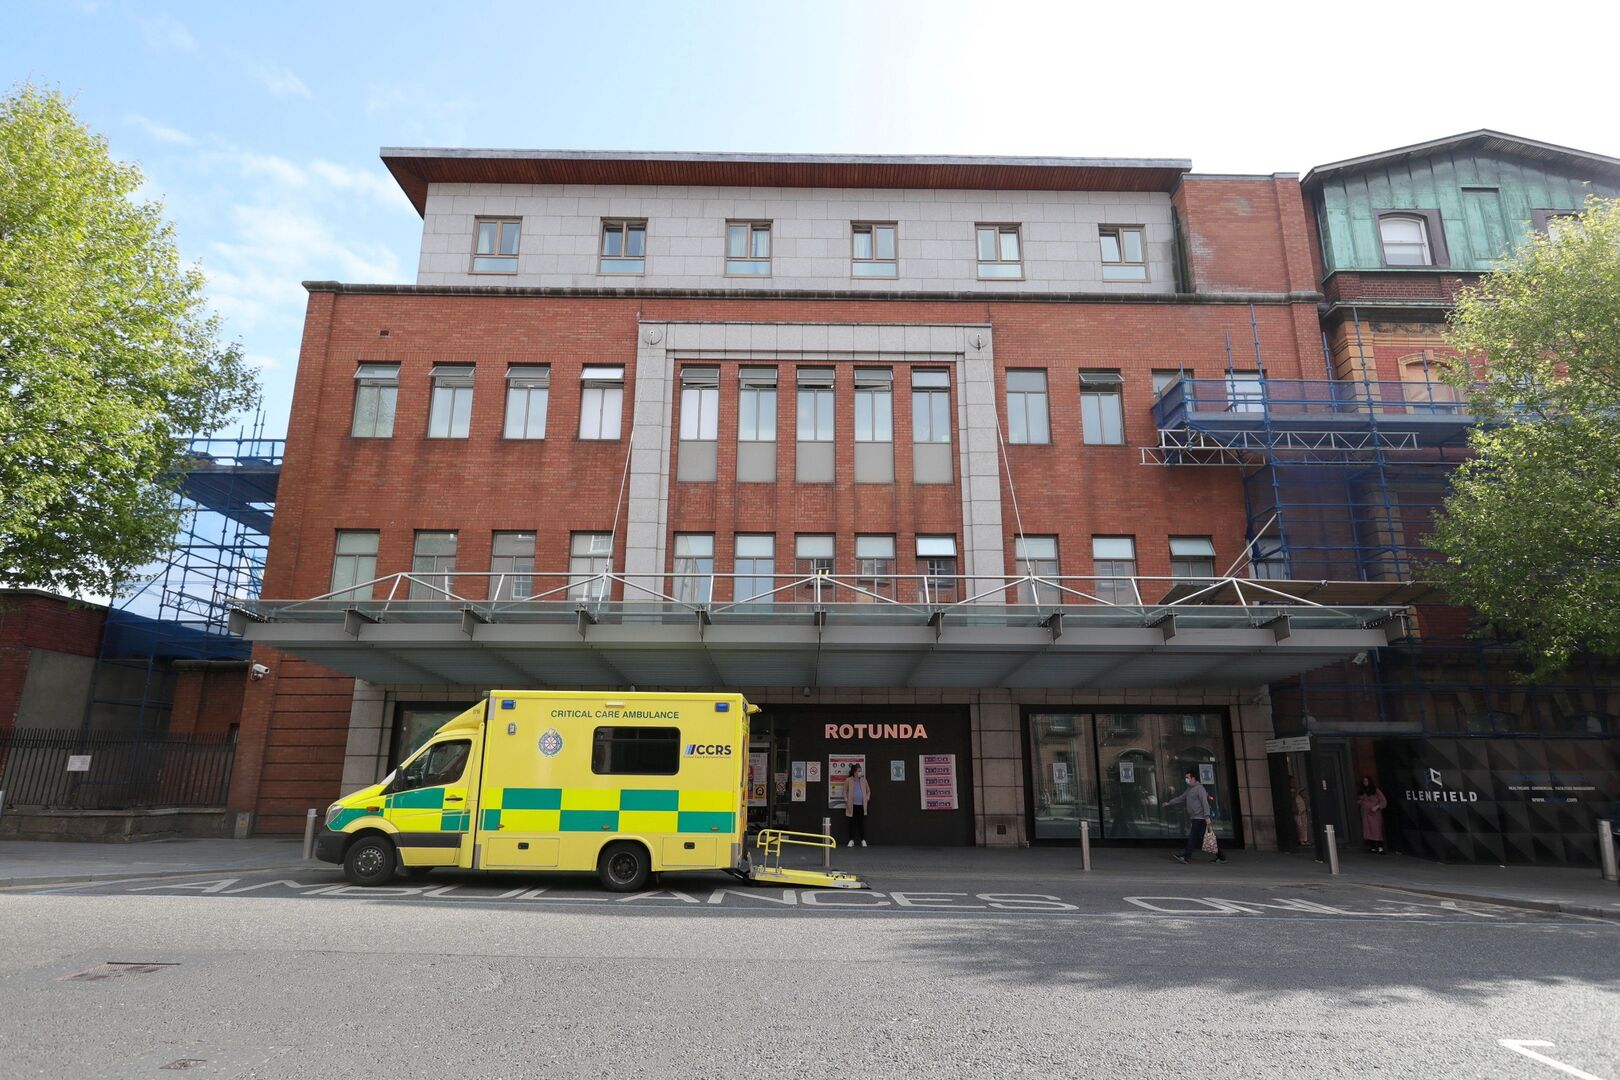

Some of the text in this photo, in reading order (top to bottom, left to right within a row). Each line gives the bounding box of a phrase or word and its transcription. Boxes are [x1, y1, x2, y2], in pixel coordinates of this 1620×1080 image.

[550, 709, 680, 720] CRITICAL CARE AMBULANCE
[824, 723, 929, 740] ROTUNDA
[696, 744, 732, 755] CCRS
[1405, 790, 1478, 802] ELENFIELD
